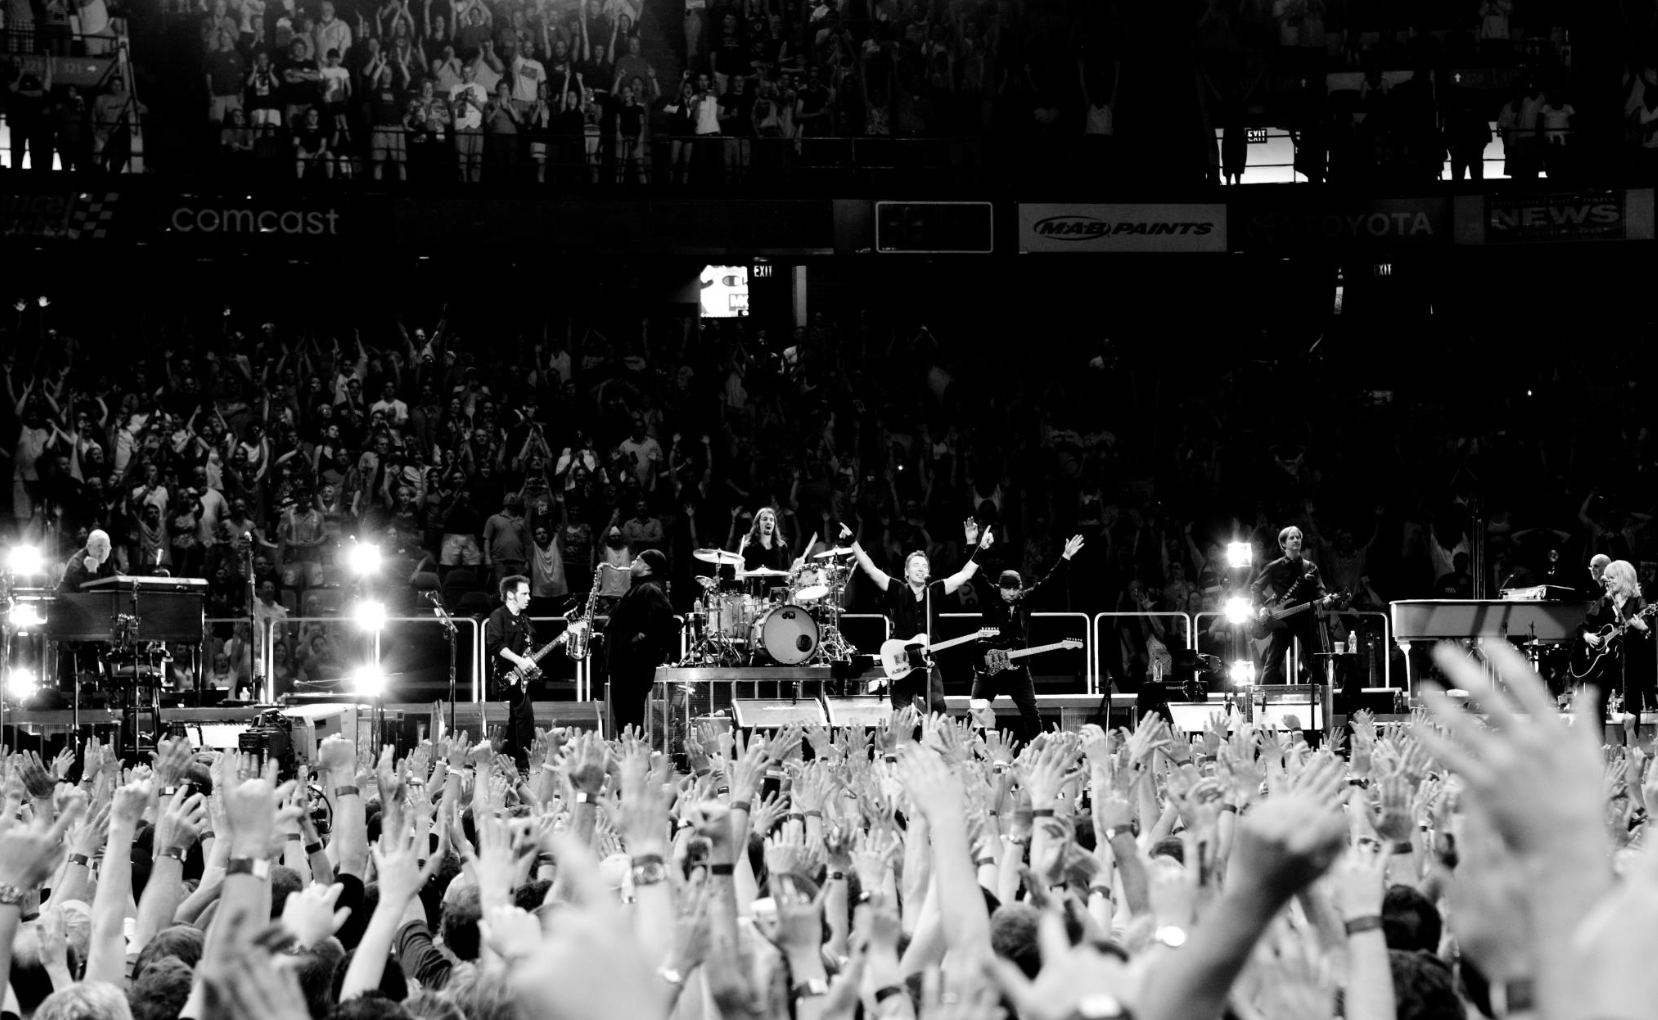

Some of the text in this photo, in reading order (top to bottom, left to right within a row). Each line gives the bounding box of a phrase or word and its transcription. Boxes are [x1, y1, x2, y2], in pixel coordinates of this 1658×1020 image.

[171, 207, 340, 235] comcast
[1299, 212, 1434, 237] TOYOTA
[1490, 203, 1621, 231] NEWS
[1111, 222, 1214, 236] PAINTS
[753, 265, 773, 277] EXIT
[1373, 263, 1392, 276] EXIT
